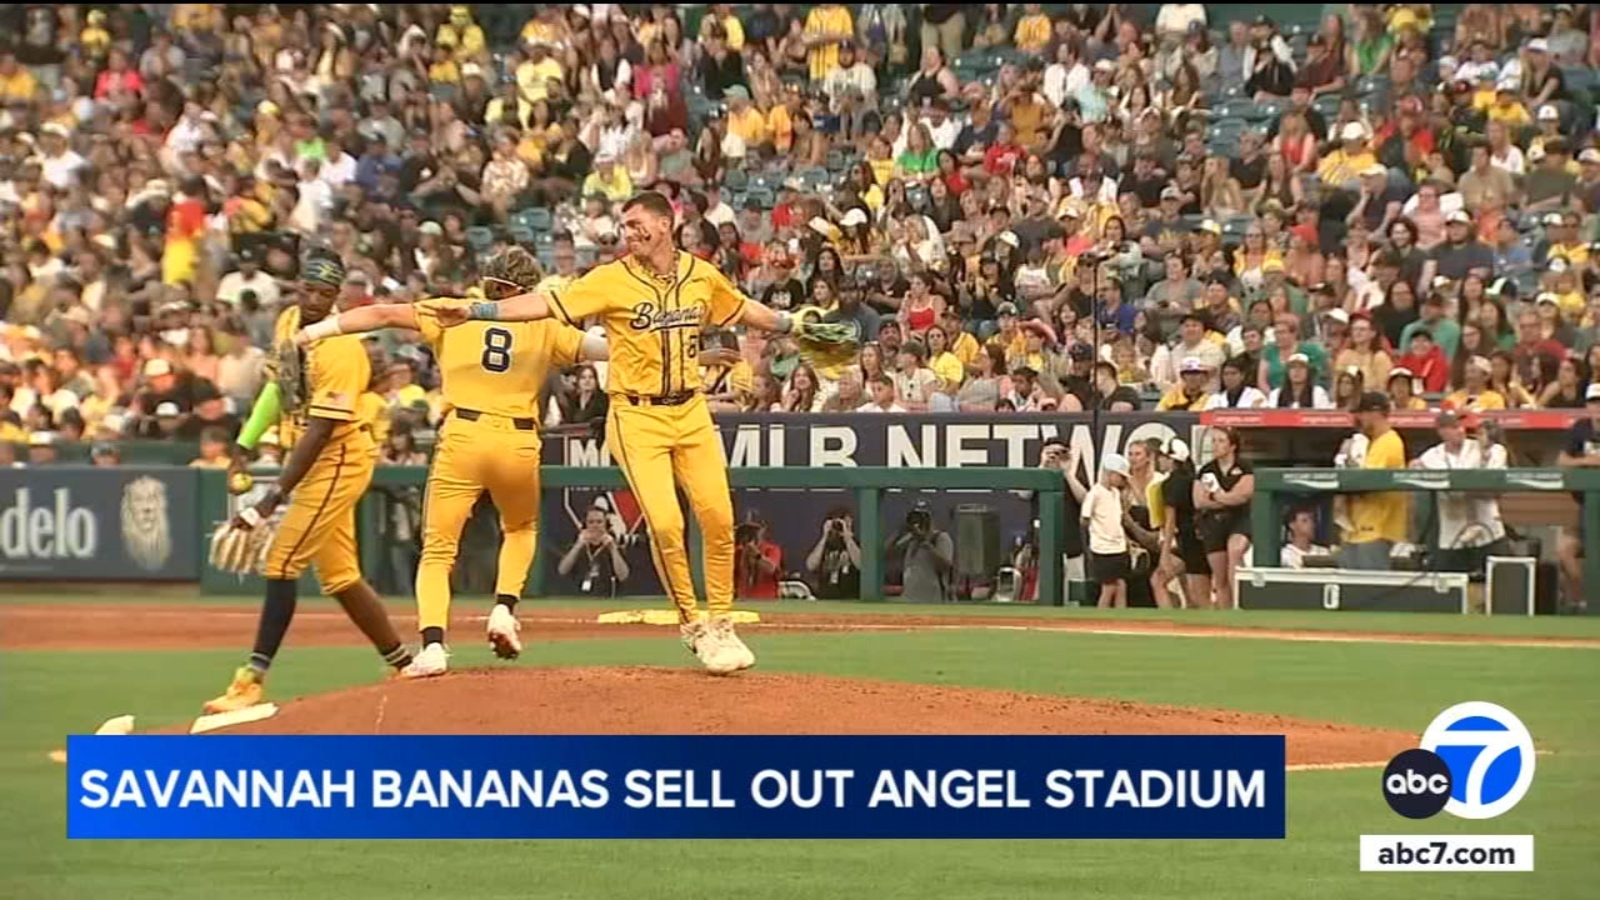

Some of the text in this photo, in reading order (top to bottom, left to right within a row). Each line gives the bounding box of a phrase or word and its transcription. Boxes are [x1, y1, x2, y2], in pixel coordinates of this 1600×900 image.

[482, 327, 512, 373] 8
[713, 424, 859, 488] MLB
[0, 487, 97, 558] delo
